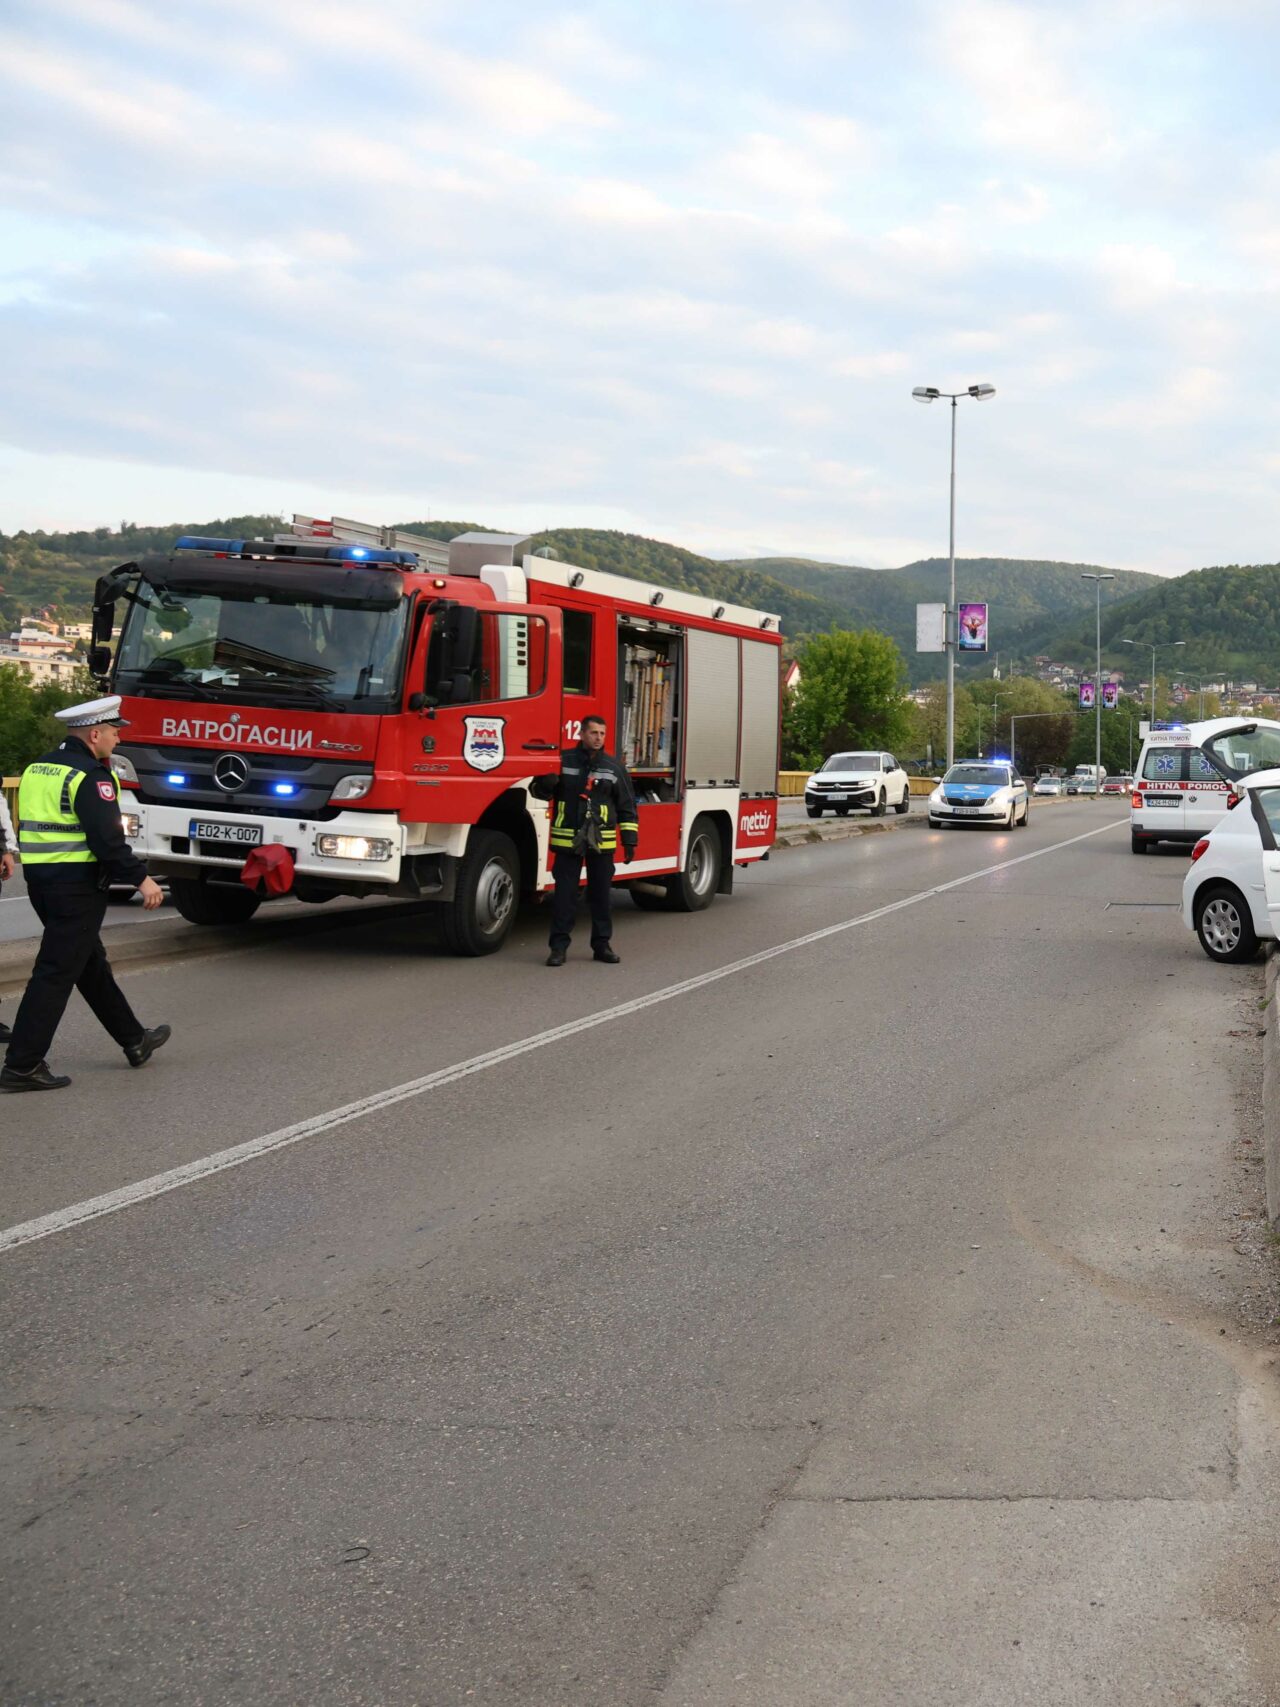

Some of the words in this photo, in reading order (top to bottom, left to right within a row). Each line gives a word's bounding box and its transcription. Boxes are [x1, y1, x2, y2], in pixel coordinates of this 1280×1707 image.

[162, 718, 313, 750] ВАТРОГАСЦИ
[565, 720, 581, 740] 12
[1147, 782, 1180, 790] HITNA
[37, 823, 80, 832] ПОЛИЦИЈ
[197, 824, 258, 842] E02-K-007
